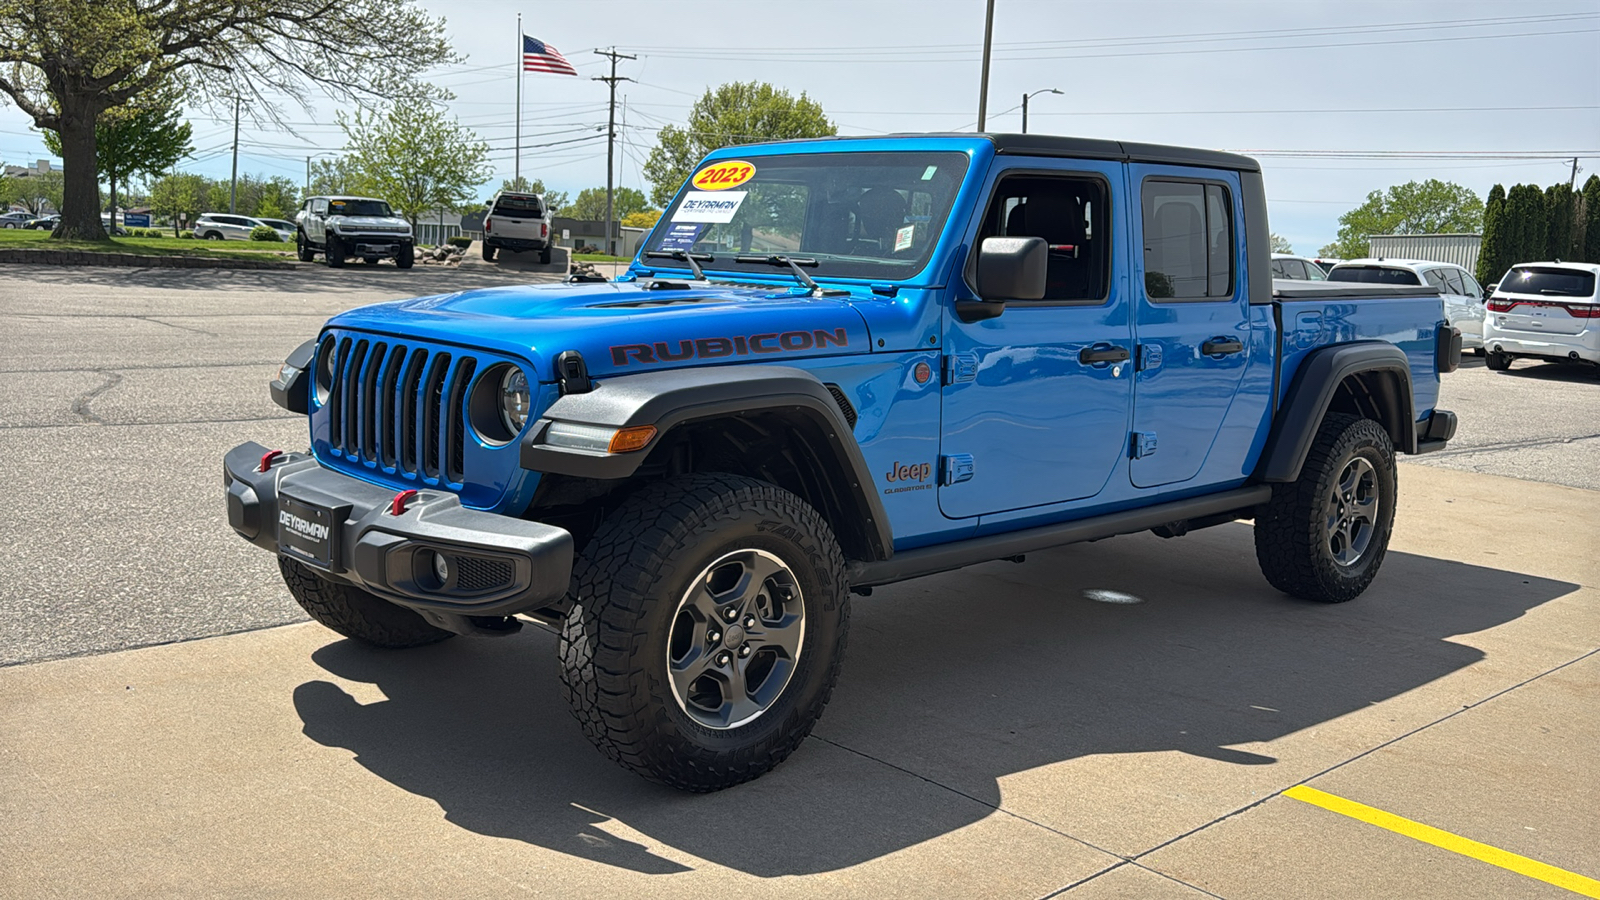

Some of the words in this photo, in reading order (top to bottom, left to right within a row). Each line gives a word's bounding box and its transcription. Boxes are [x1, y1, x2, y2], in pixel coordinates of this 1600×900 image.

[697, 167, 751, 184] 2023
[683, 200, 738, 210] DEYARMAN
[609, 328, 848, 366] RUBICON
[886, 461, 931, 482] Jeep
[884, 485, 925, 494] GLADIATOR
[279, 510, 329, 540] DEYARMAN
